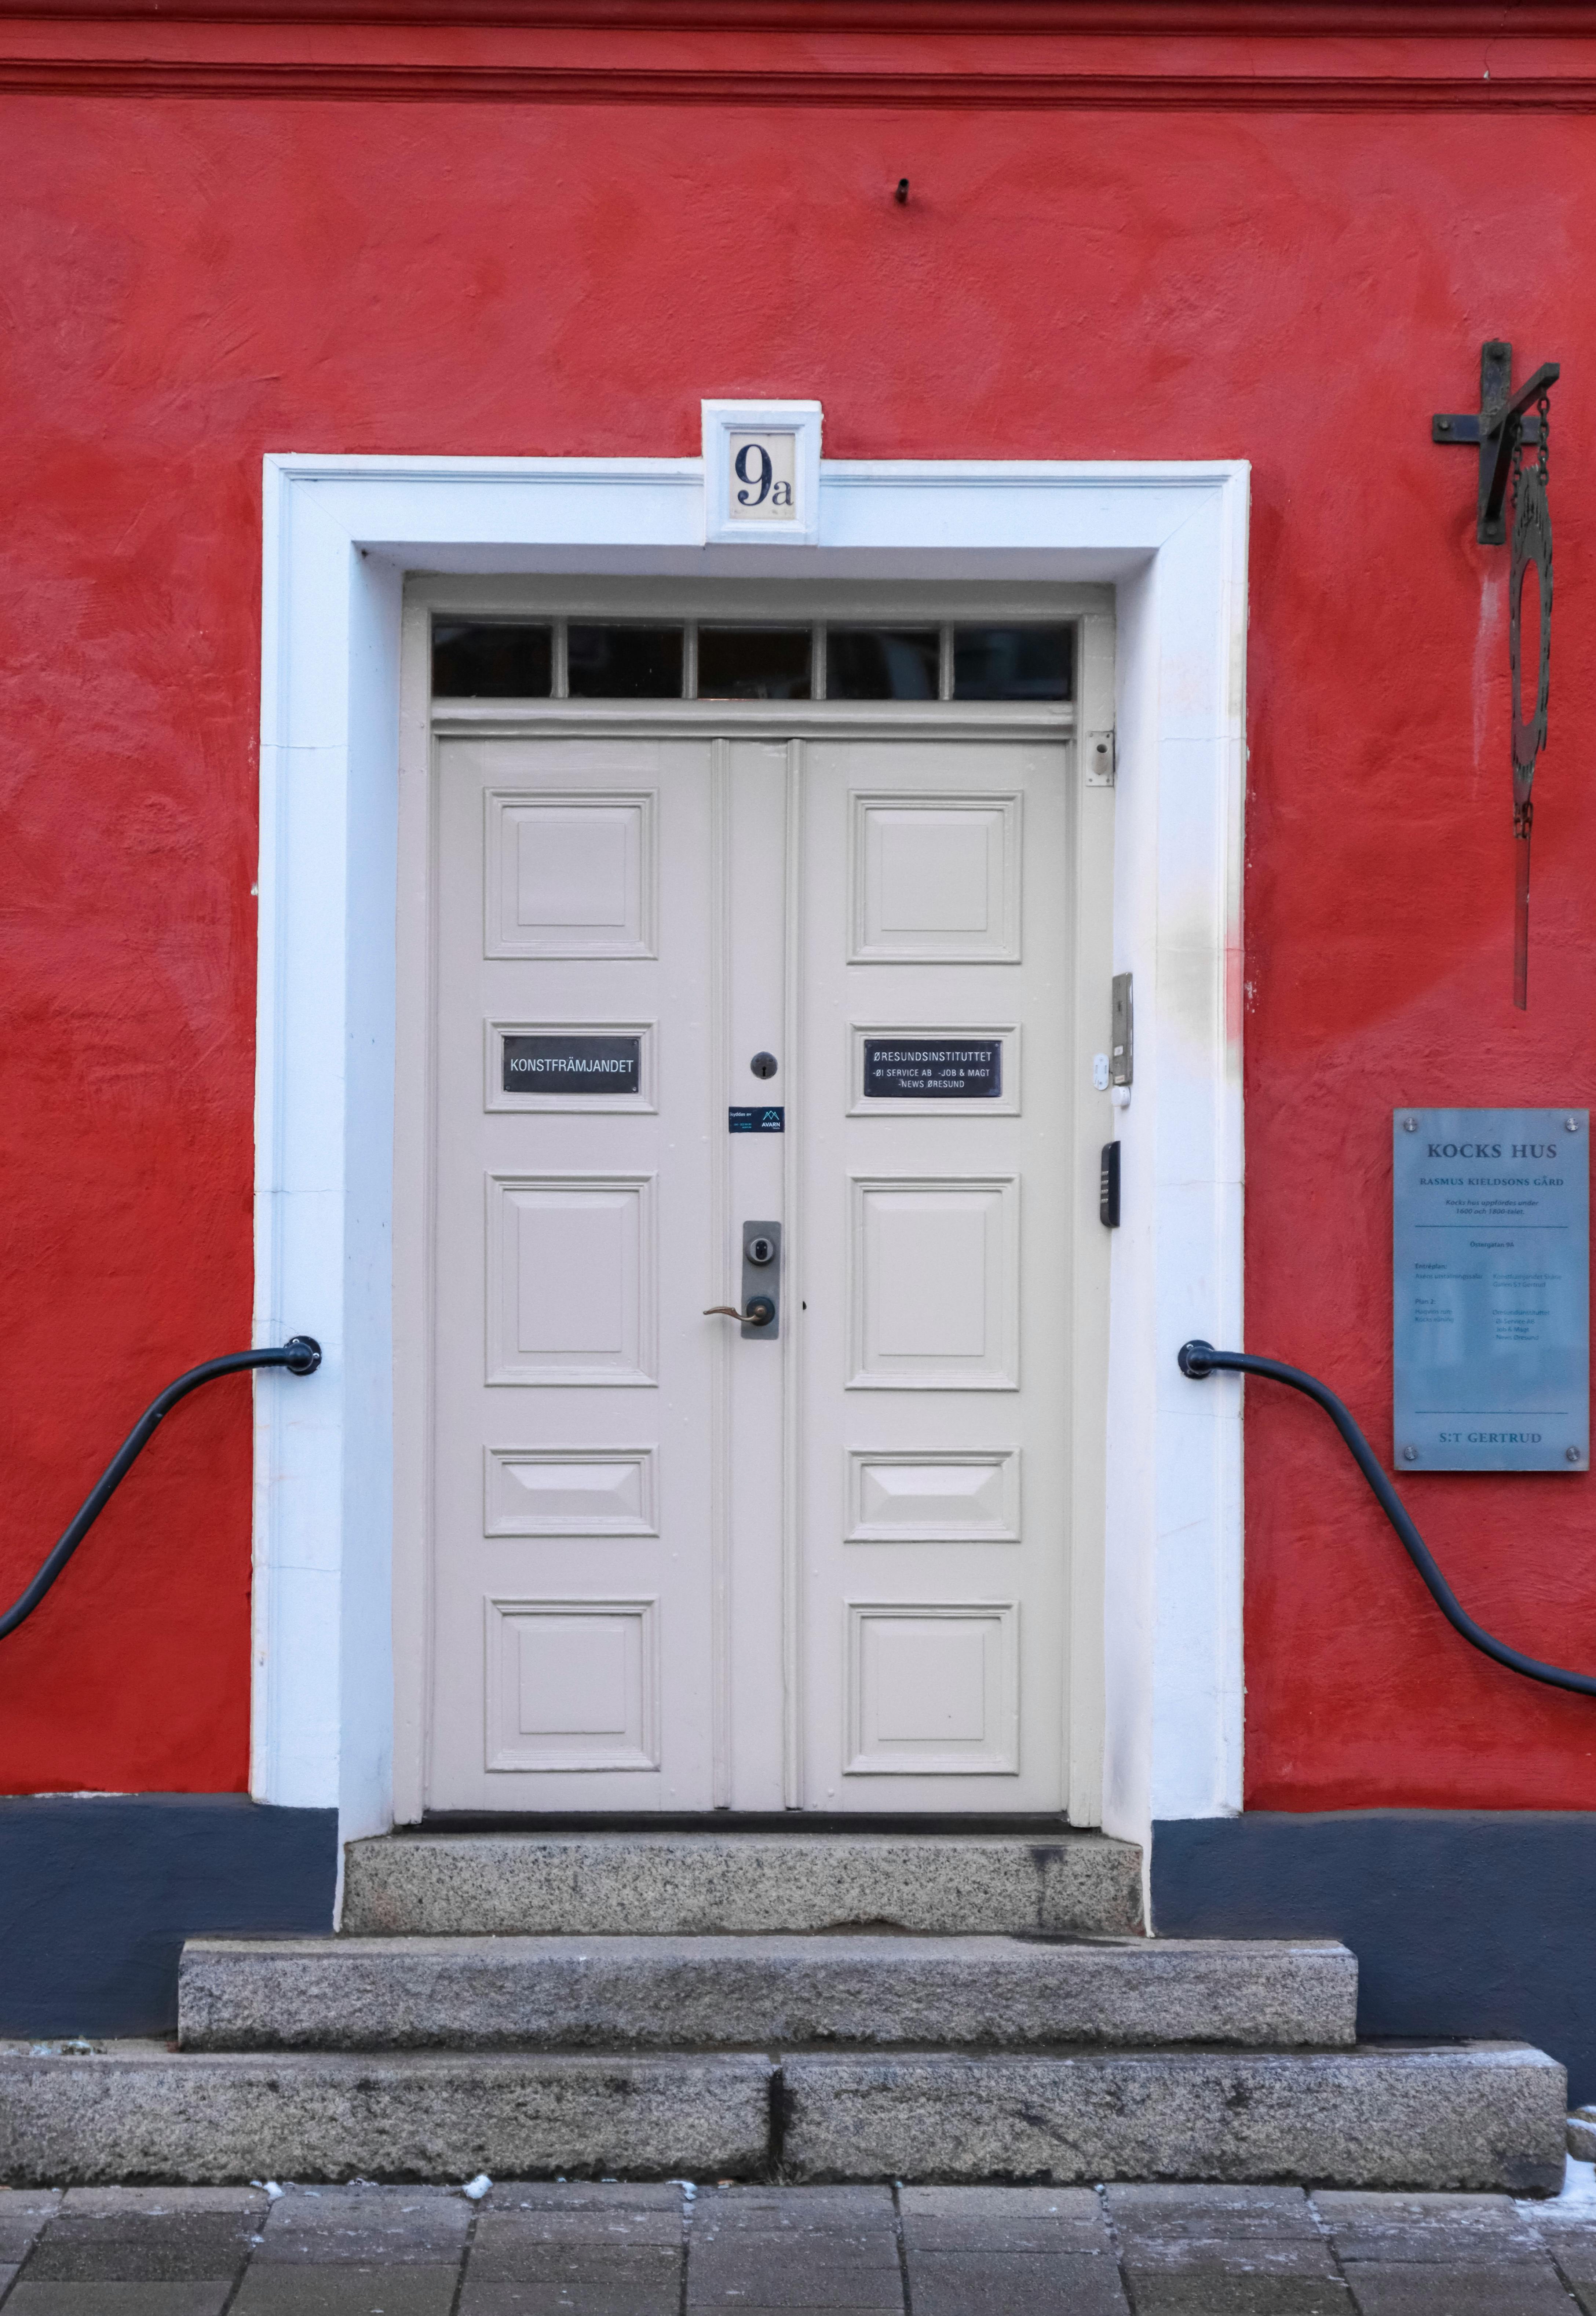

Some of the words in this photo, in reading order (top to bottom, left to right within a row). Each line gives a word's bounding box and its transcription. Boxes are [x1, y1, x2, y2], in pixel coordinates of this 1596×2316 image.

[735, 444, 794, 506] 9a
[874, 1052, 992, 1061] ØRESUNDSINSTITUTTET
[510, 1057, 634, 1073] KONSTFRÄMJANDET
[1427, 1144, 1501, 1158] KOCKS
[1512, 1144, 1557, 1158] HUS
[1534, 1175, 1564, 1186] GÅRD
[1439, 1432, 1462, 1442] S:T
[1468, 1432, 1542, 1443] GERTRUD
